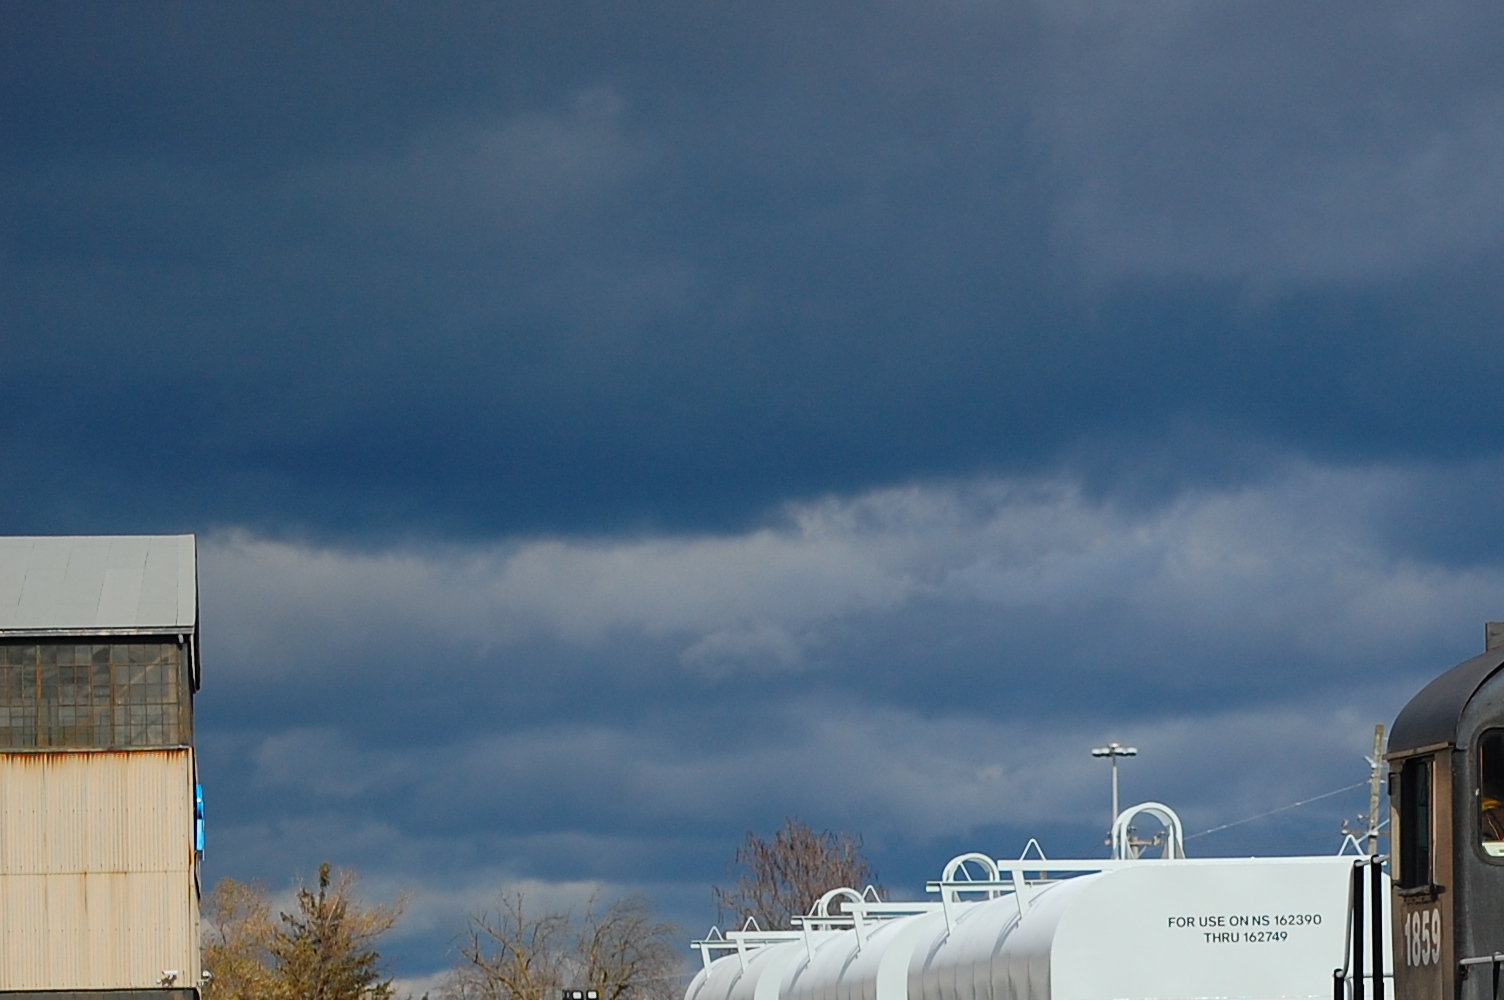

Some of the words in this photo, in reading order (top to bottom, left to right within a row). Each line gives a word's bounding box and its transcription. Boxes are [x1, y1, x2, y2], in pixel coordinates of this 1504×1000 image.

[1168, 916, 1195, 928] FOR
[1199, 915, 1226, 927] USE
[1229, 915, 1249, 927] ON
[1252, 914, 1270, 926] NS
[1275, 914, 1322, 926] 162390
[1204, 932, 1240, 943] THRU
[1244, 931, 1288, 943] 162749
[1404, 908, 1441, 968] 1859
